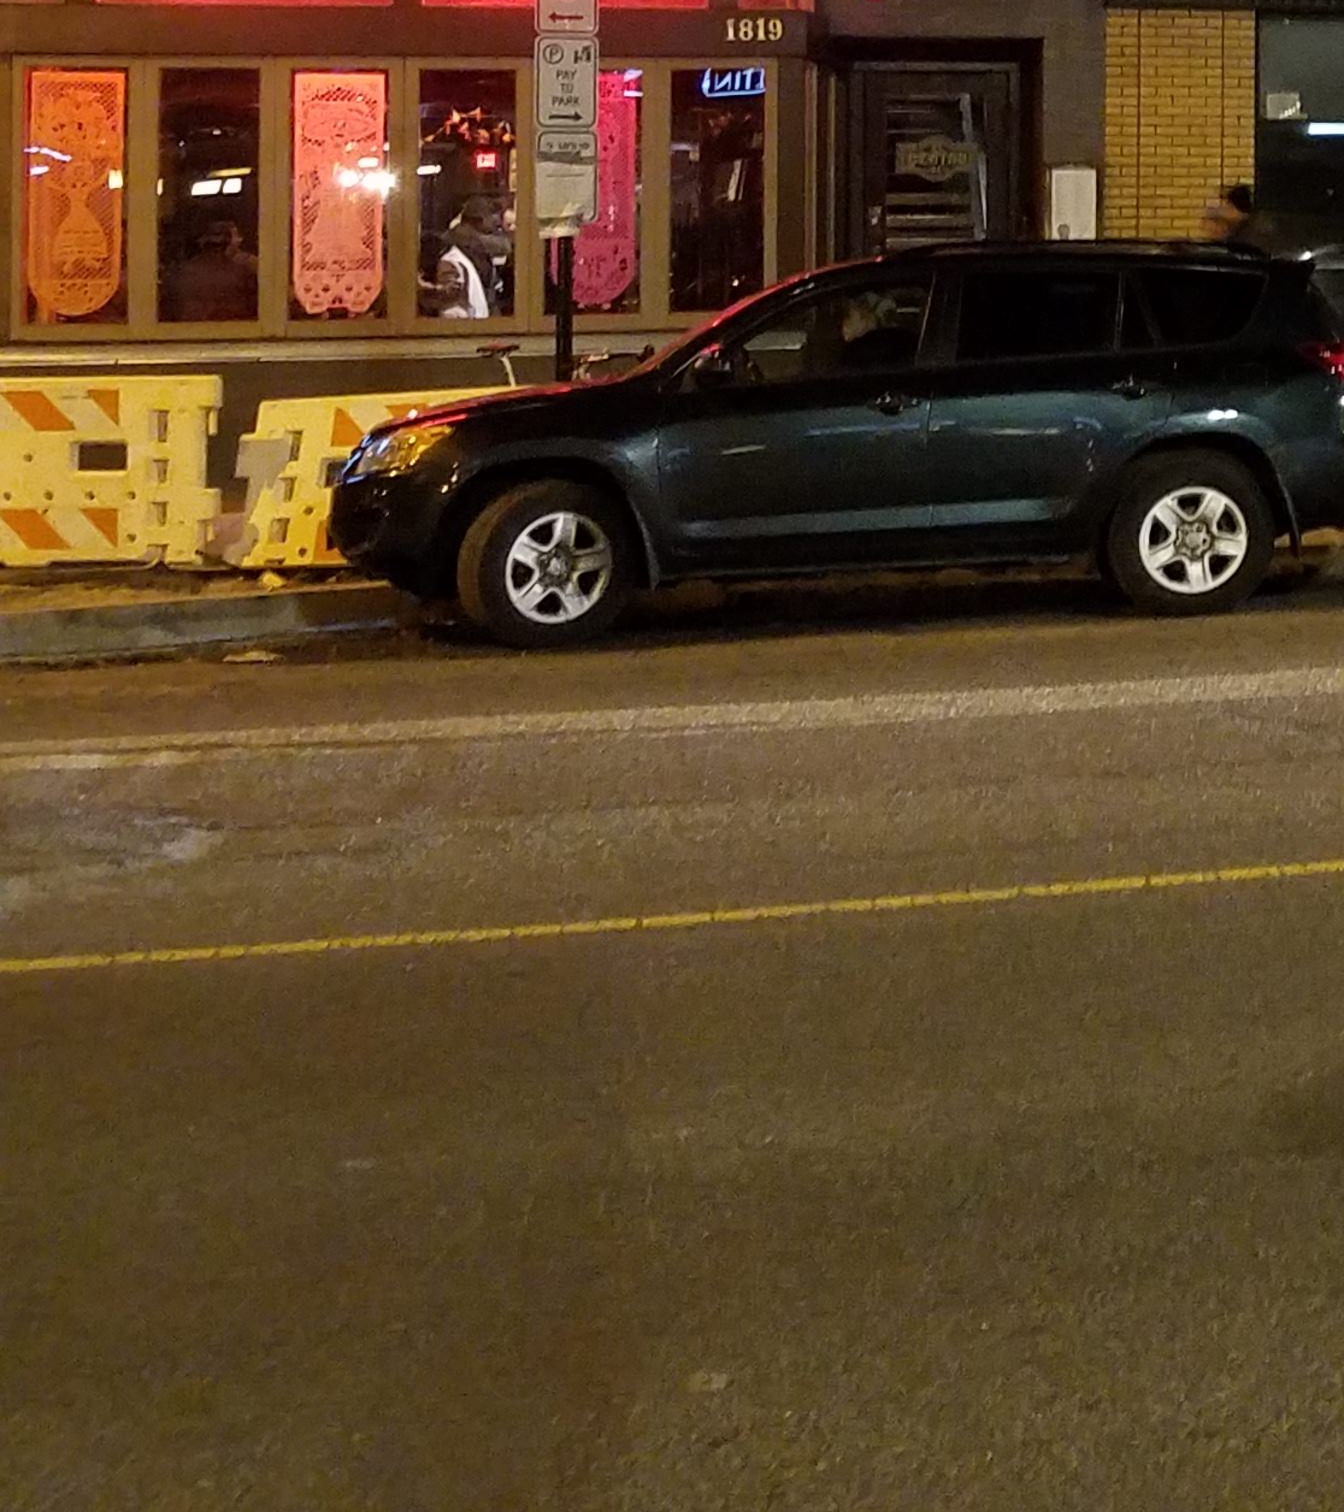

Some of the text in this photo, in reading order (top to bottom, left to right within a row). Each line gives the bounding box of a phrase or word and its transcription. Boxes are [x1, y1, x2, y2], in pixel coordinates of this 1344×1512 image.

[725, 17, 783, 42] 1819
[556, 69, 577, 80] PAY
[560, 83, 574, 93] TO
[552, 95, 581, 106] PARK
